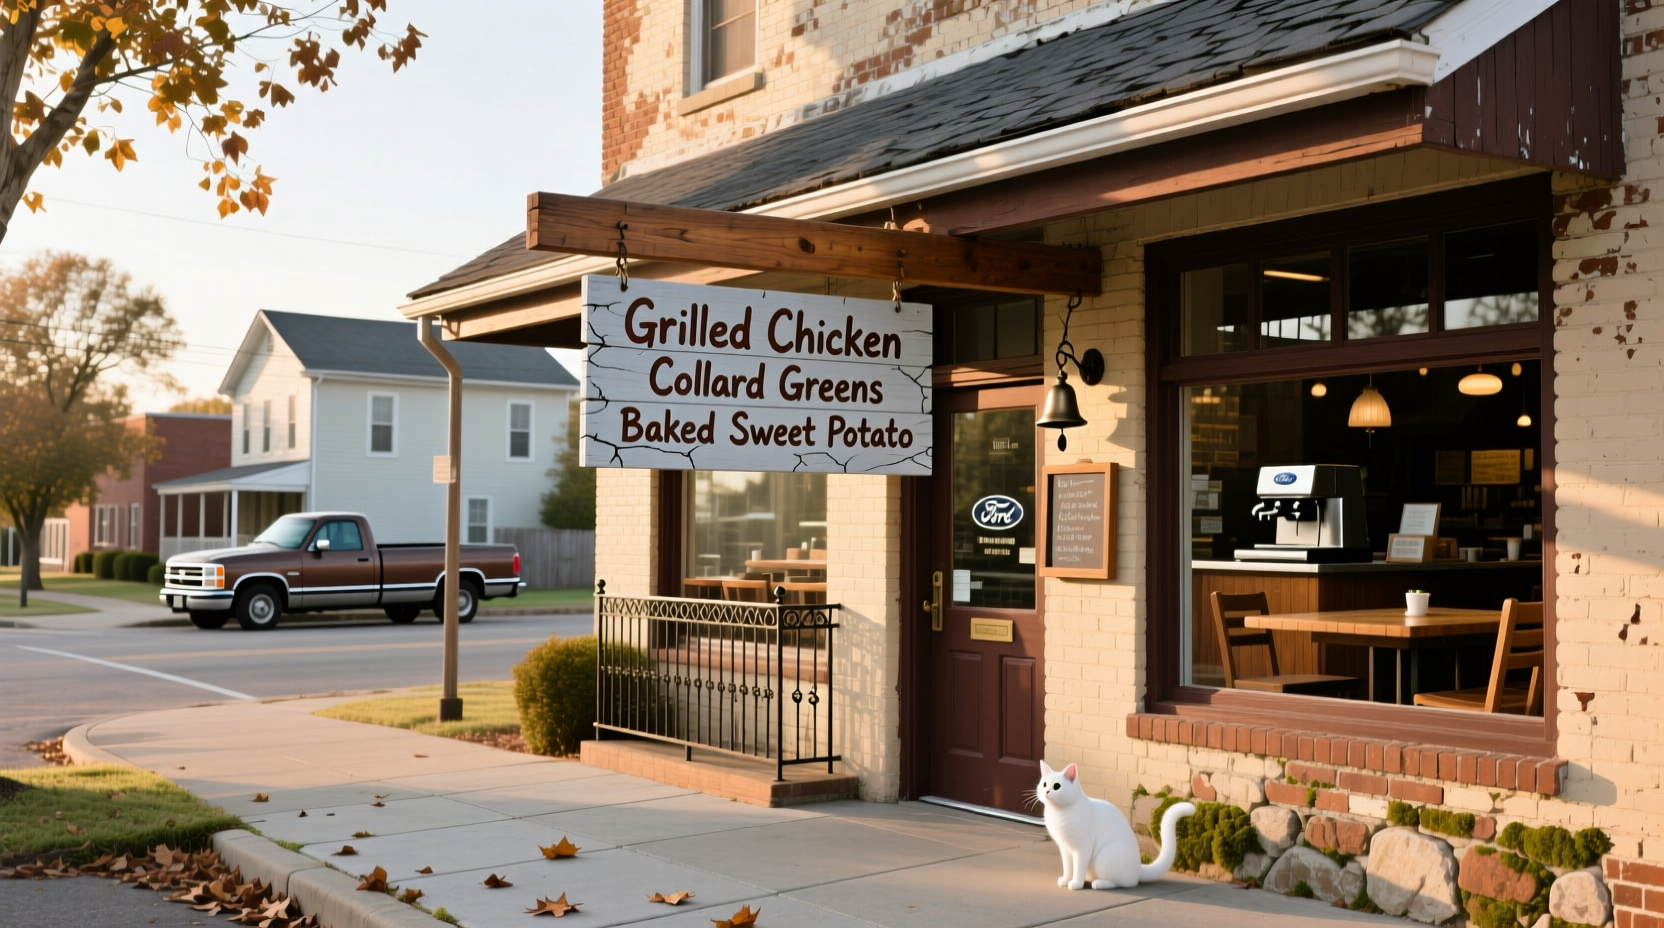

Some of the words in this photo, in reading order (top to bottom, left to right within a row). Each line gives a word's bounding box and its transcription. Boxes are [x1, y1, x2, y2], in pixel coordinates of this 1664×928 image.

[625, 297, 752, 350] Grilled
[768, 308, 901, 359] Chicken
[649, 356, 765, 399] Collard
[779, 365, 883, 405] Greens
[620, 406, 715, 444] Baked
[729, 411, 816, 446] Sweet
[827, 415, 913, 449] Potato
